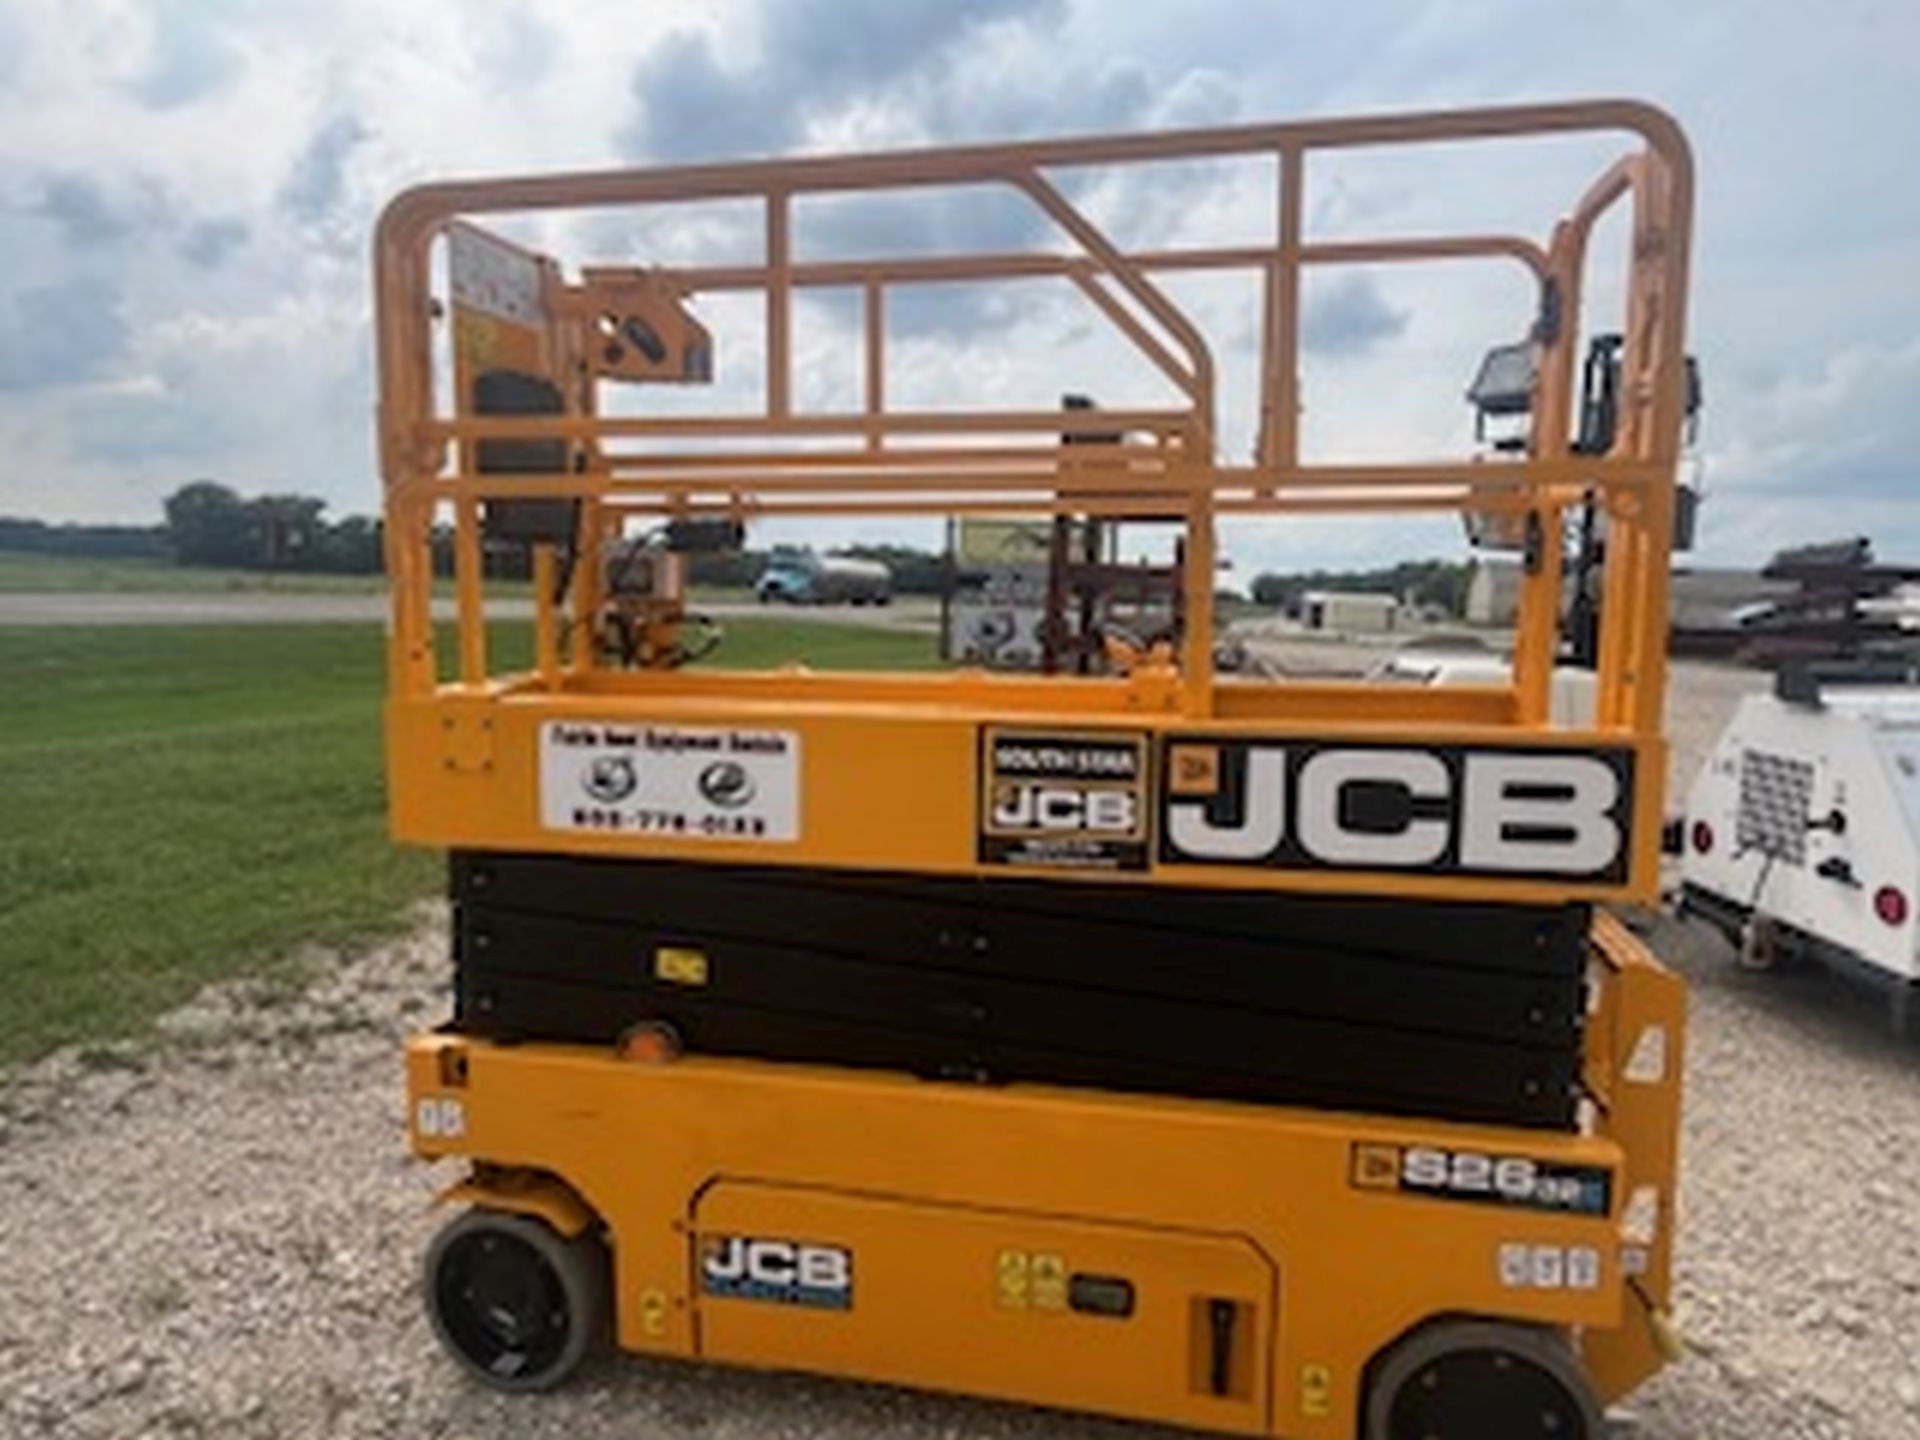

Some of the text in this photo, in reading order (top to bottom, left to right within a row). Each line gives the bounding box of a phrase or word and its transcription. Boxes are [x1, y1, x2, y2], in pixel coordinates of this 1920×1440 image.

[994, 783, 1135, 829] JCB
[1168, 746, 1620, 873] JCB
[706, 1237, 849, 1287] JCB
